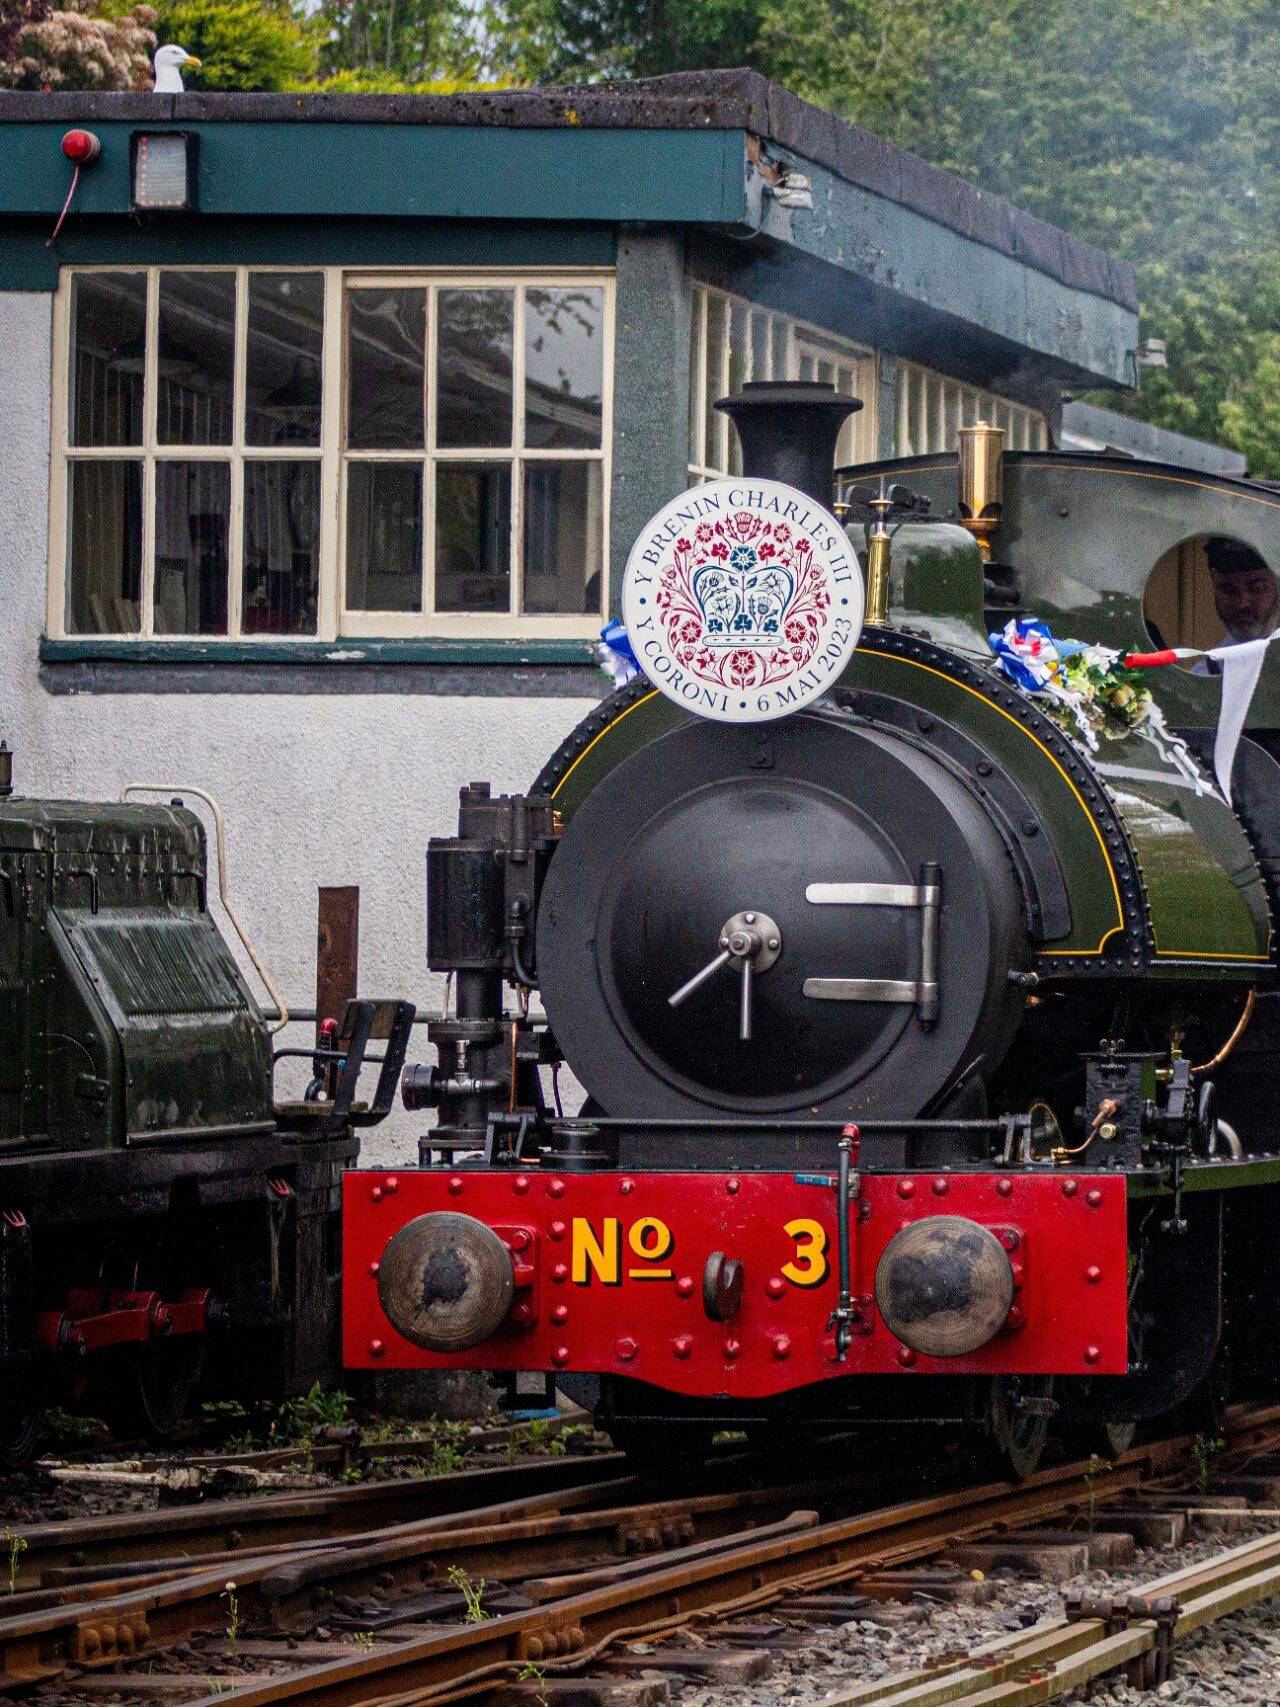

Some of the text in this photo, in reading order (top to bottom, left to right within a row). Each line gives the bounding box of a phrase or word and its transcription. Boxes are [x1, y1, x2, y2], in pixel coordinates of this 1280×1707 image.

[634, 489, 852, 586] Y BRENIN CHARLES III
[635, 615, 853, 712] Y CORONI 6 MAI 2023
[782, 1218, 828, 1285] 3
